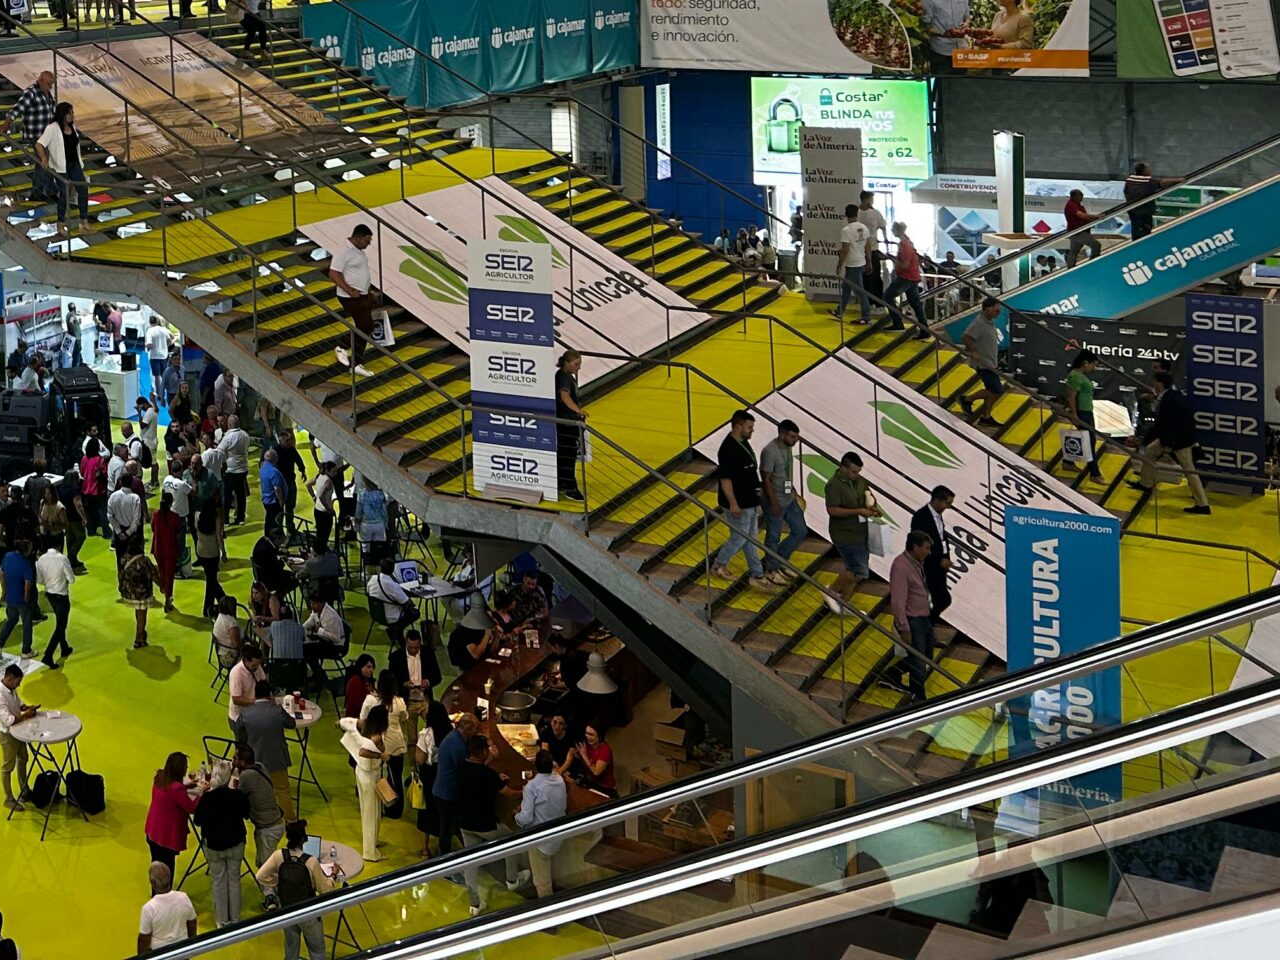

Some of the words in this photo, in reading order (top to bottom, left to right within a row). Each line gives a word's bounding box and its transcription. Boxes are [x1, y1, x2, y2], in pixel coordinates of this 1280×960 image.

[555, 17, 586, 35] cajamar
[605, 10, 631, 26] cajamar
[651, 13, 729, 26] rendimiento
[503, 25, 536, 44] cajamar
[650, 31, 659, 41] e
[663, 29, 739, 43] innovación.
[444, 36, 480, 57] cajamar
[836, 91, 885, 103] Costar
[820, 109, 873, 120] BLINDA
[895, 147, 913, 158] 62
[1154, 228, 1235, 273] cajamar
[484, 253, 534, 273] SER
[484, 271, 535, 281] AGRICULTOR
[485, 304, 535, 324] SER
[1192, 310, 1257, 334] SER
[1081, 341, 1133, 358] lmería
[1192, 344, 1258, 368] SER
[487, 355, 537, 376] SER
[488, 373, 538, 384] AGRICULTOR
[1193, 377, 1258, 402] SER
[1193, 410, 1259, 436] SER
[490, 454, 539, 476] SER
[490, 472, 540, 484] AGRICULTOR
[1012, 514, 1113, 535] agricultura2000.com
[1032, 537, 1062, 751] AGRULTURA
[1066, 685, 1094, 740] 000
